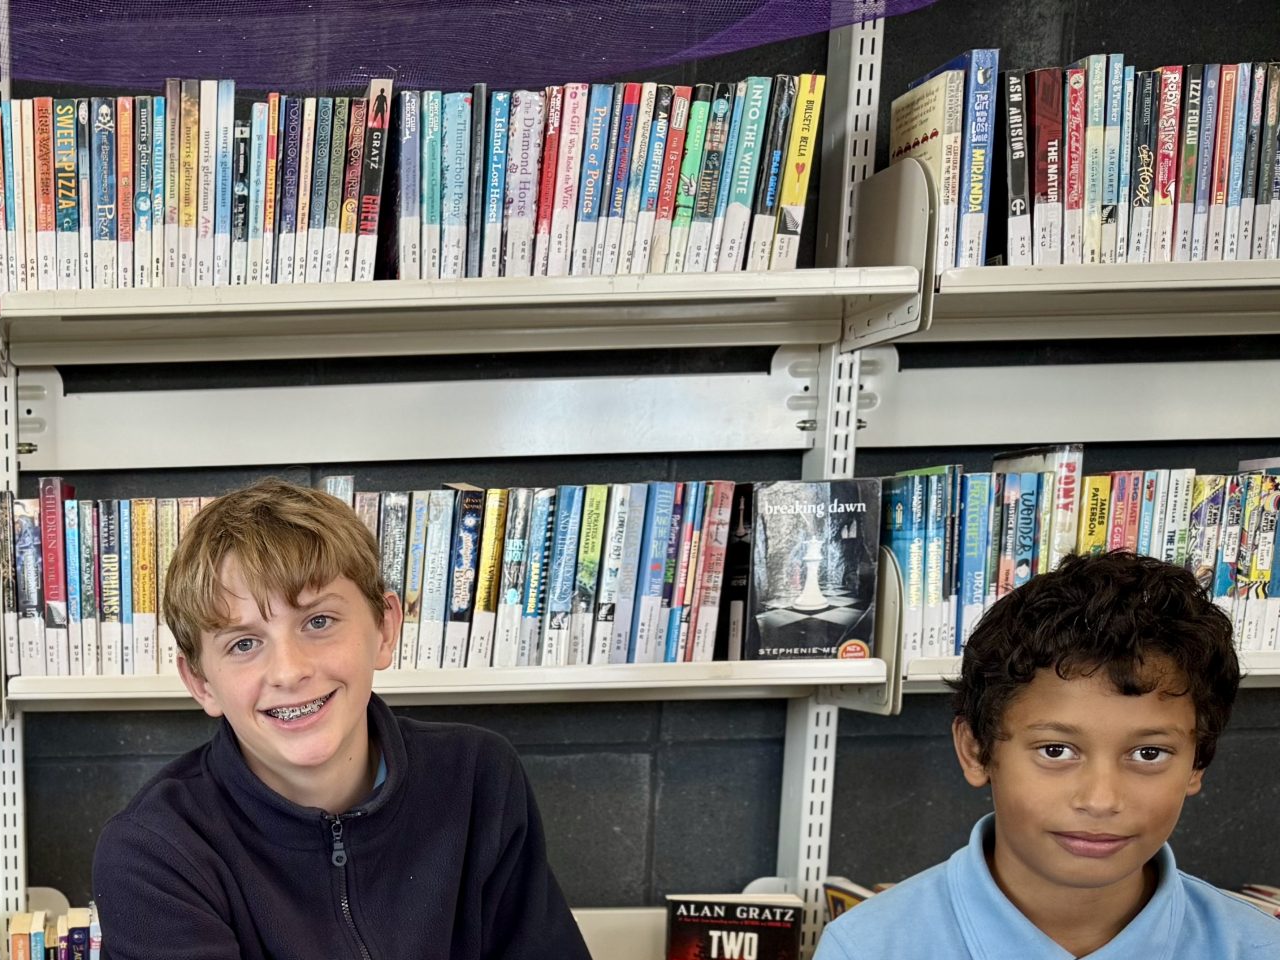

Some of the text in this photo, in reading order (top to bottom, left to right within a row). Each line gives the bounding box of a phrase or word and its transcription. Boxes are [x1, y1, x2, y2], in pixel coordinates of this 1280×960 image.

[494, 117, 505, 153] Island
[590, 106, 608, 150] Prince
[797, 100, 815, 157] BULLSEYE BELLA
[1009, 76, 1025, 160] ASH ARISING
[1186, 79, 1202, 145] IZZY FOLAU
[56, 104, 77, 210] SWEET PIZZA
[370, 131, 381, 169] GRATZ
[648, 112, 668, 193] ANDY GRIFFITHS
[736, 84, 764, 195] INTO THE WHITE
[1048, 139, 1058, 163] THE
[201, 166, 212, 212] gleitzman
[451, 120, 466, 219] Thunderbolt Pony
[517, 117, 534, 217] Diamond Horse
[583, 169, 599, 214] Ponies
[969, 148, 986, 212] MIRANDA
[764, 499, 866, 517] breaking dawn
[1055, 462, 1077, 513] PONY
[1087, 487, 1100, 536] PATTERSON
[1098, 498, 1107, 525] JAMES
[46, 486, 57, 547] CHILDREN
[758, 647, 818, 656] STEPHENIE
[676, 904, 794, 922] ALAN GRATZ
[709, 930, 759, 960] TWO
